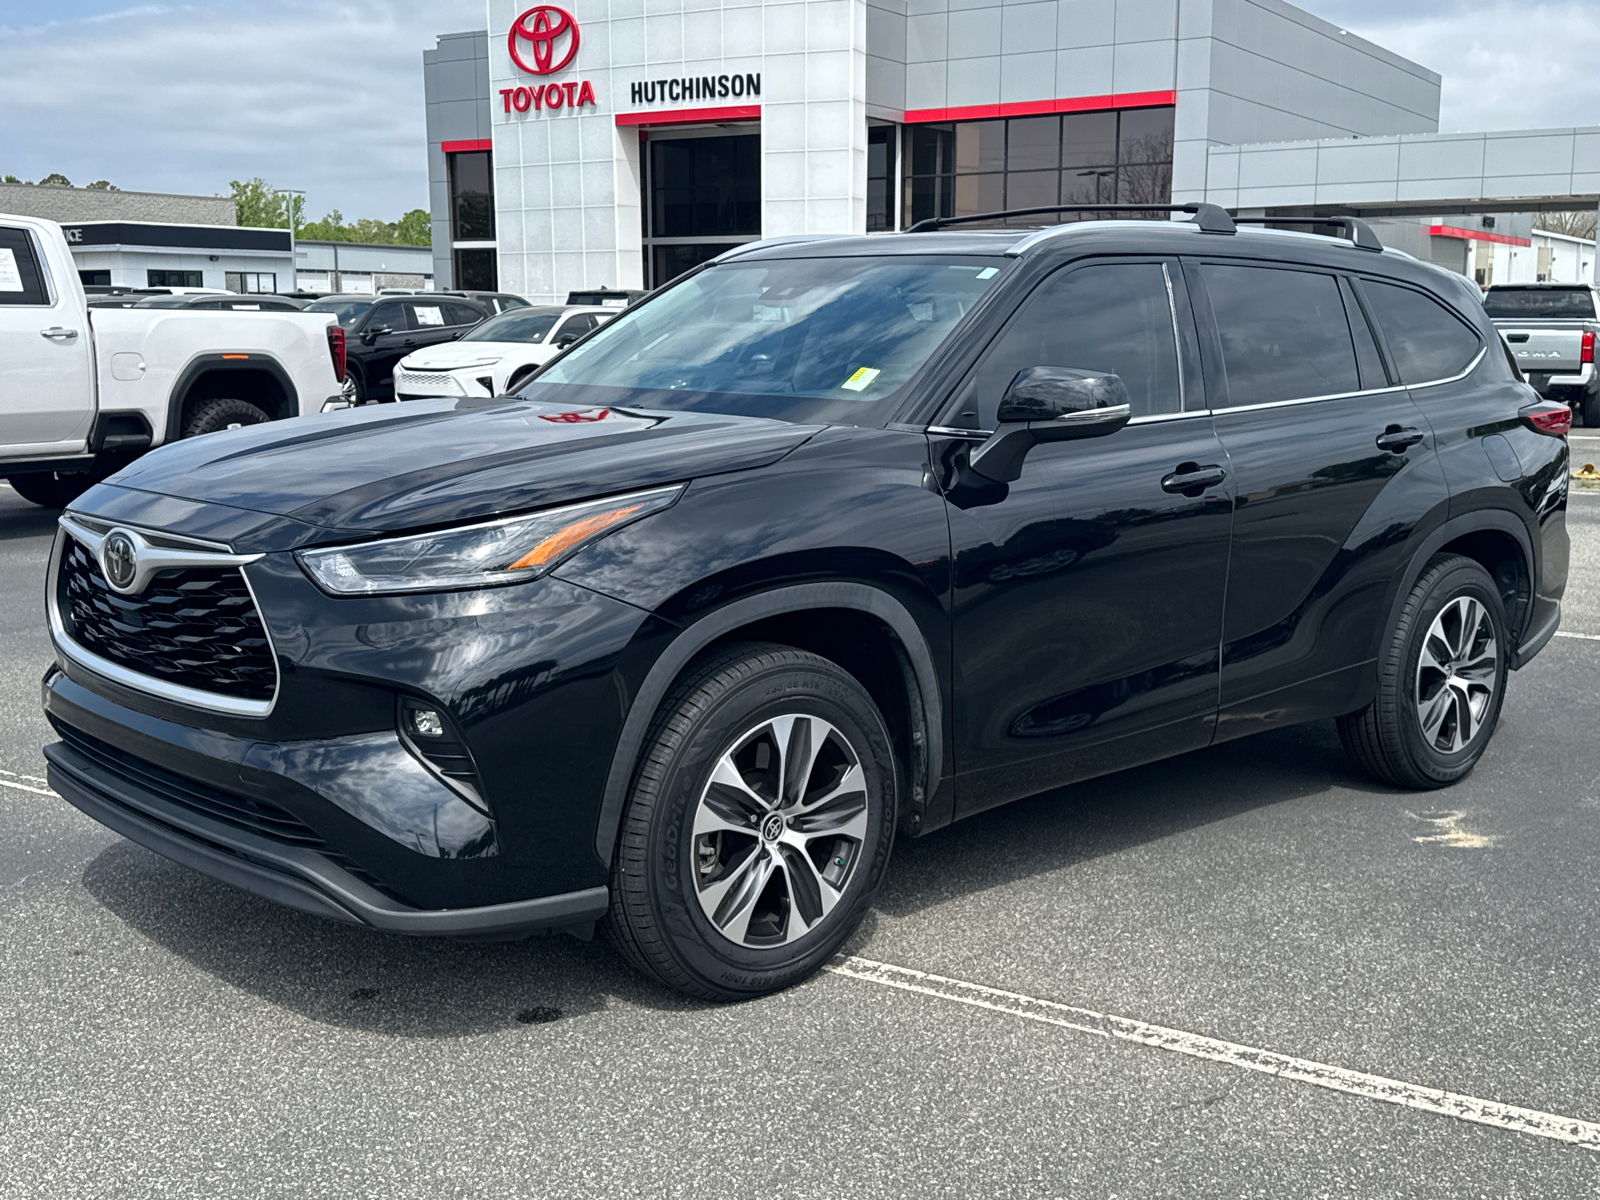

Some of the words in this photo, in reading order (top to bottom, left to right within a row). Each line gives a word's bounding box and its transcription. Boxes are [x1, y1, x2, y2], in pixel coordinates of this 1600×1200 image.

[499, 81, 596, 113] TOYOTA
[631, 73, 761, 103] HUTCHINSON
[64, 228, 83, 242] ICE
[664, 775, 692, 890] GeoDrive
